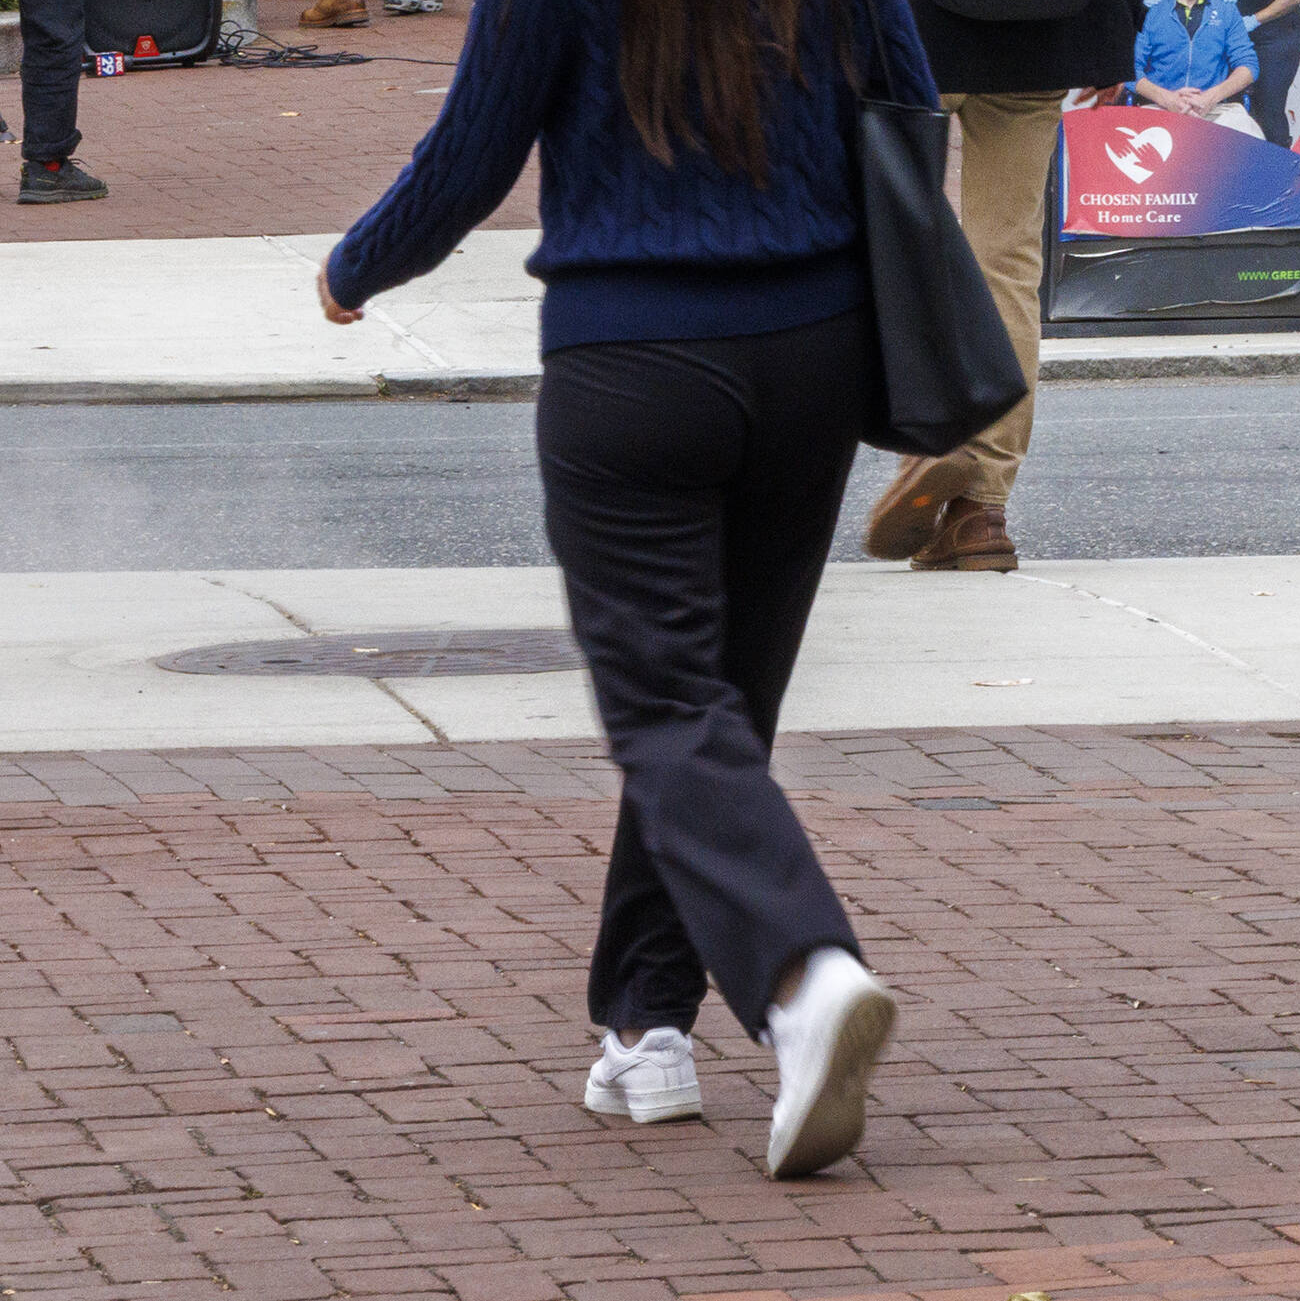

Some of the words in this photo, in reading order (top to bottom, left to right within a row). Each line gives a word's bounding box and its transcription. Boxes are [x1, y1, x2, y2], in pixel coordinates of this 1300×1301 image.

[1080, 193, 1140, 205] CHOSEN
[1145, 192, 1198, 205] FAMILY
[1097, 210, 1143, 223] Home
[1146, 210, 1182, 223] Care
